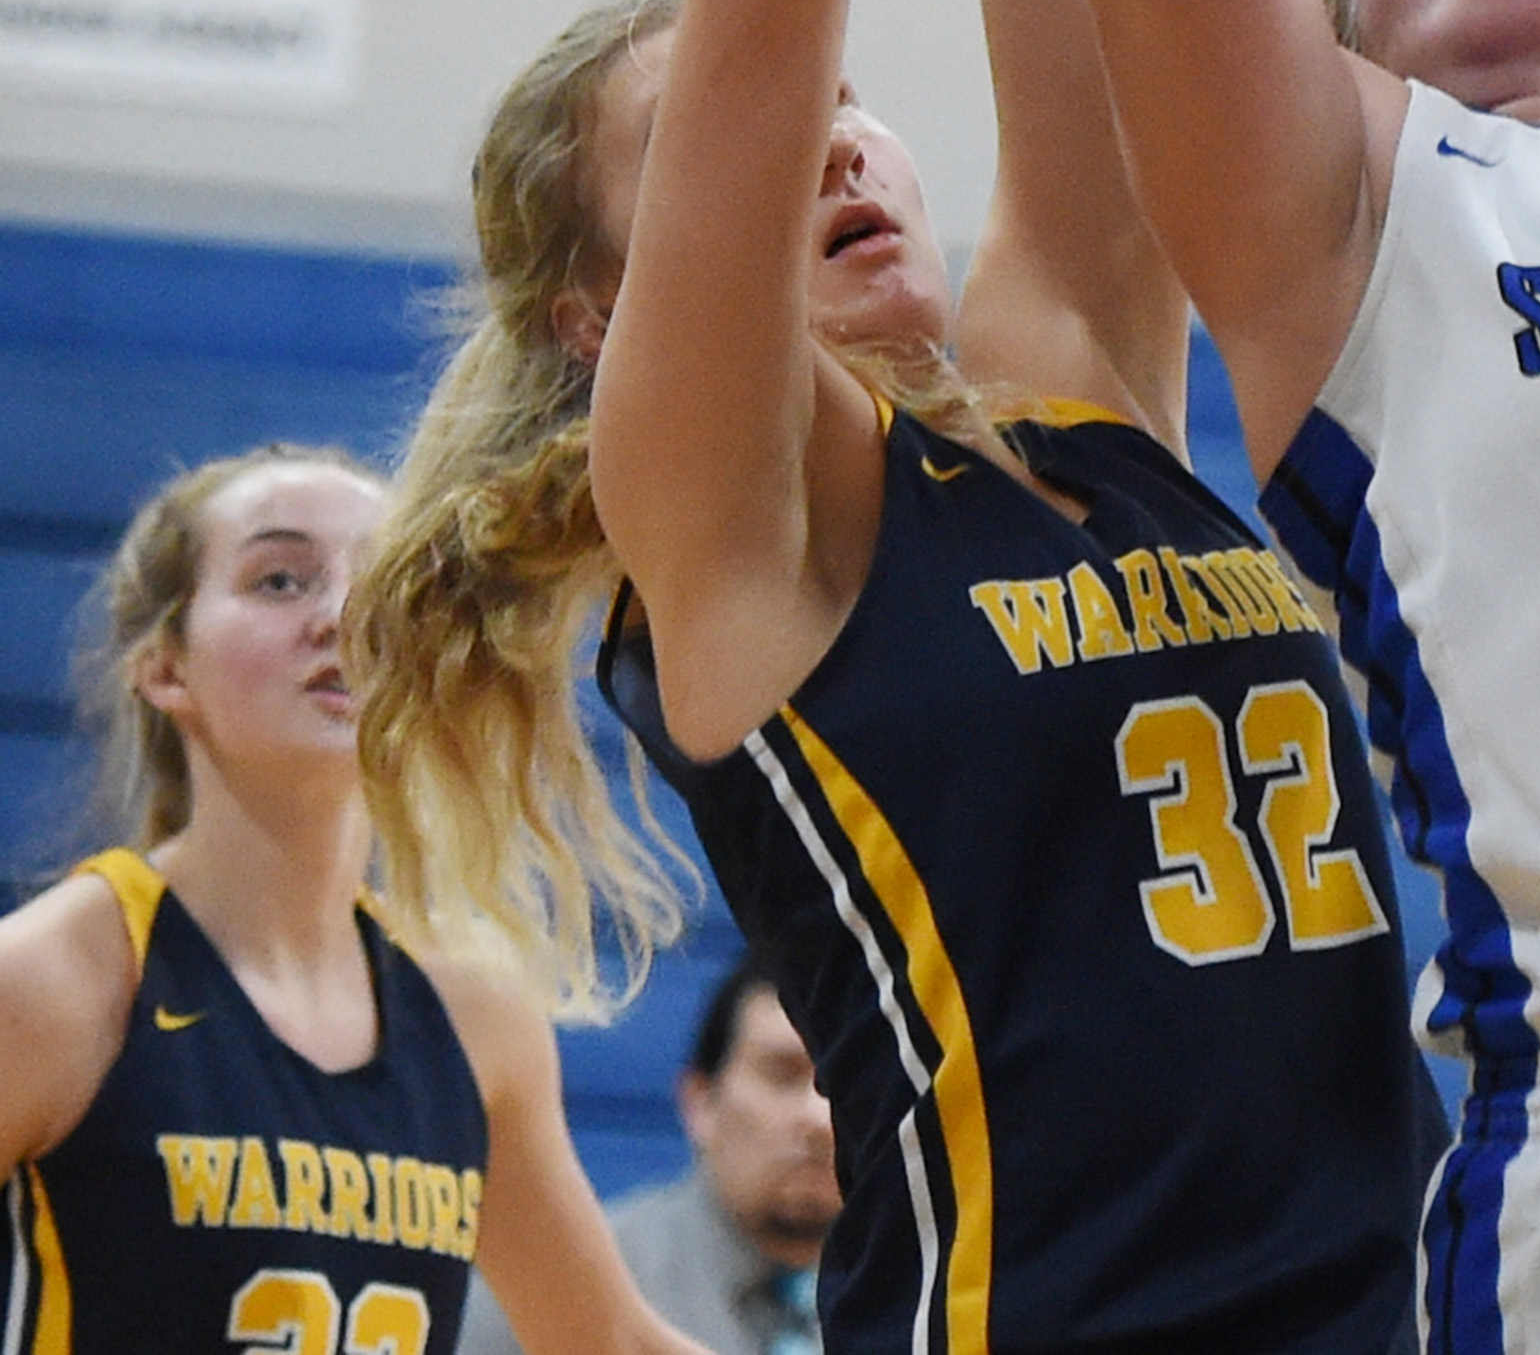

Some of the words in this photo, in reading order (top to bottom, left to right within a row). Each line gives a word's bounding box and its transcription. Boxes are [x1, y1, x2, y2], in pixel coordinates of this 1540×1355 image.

[968, 546, 1326, 677] WARRIOR
[1114, 678, 1390, 967] 32
[157, 1132, 484, 1262] WARRIORS
